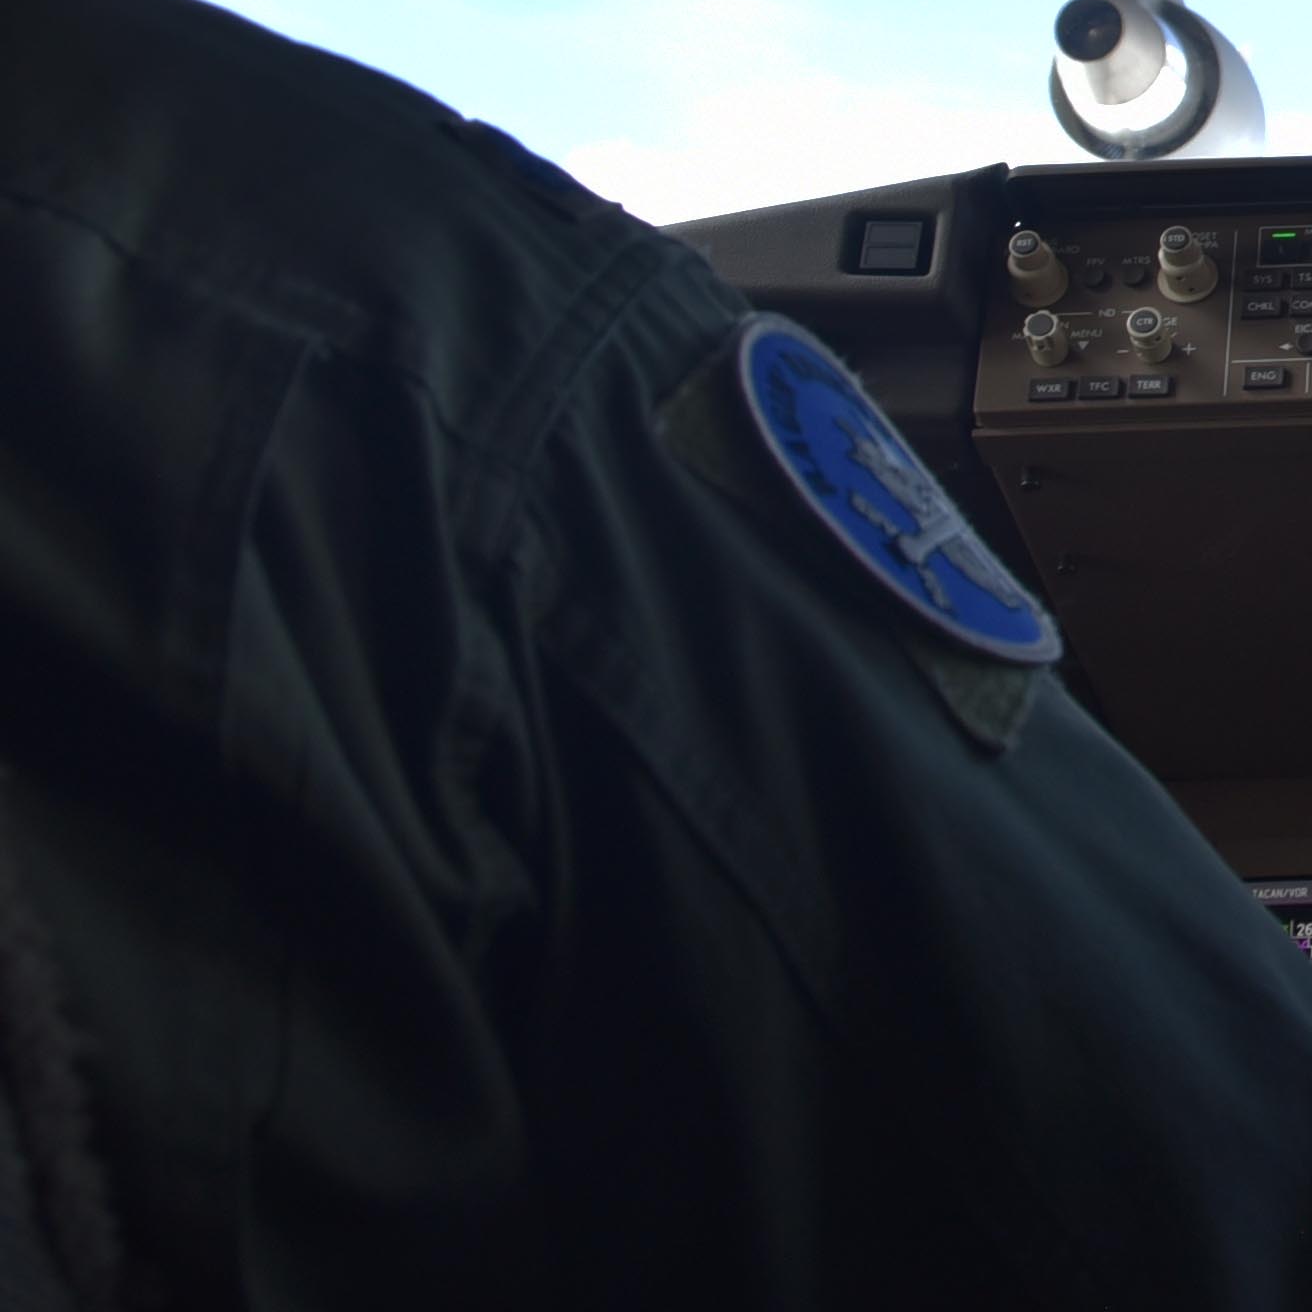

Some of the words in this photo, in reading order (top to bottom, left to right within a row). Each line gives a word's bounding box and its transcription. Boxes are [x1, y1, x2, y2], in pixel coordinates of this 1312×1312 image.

[1251, 372, 1276, 380] ENG
[1036, 384, 1062, 392] WXR
[1089, 382, 1109, 390] TFC
[1137, 380, 1161, 389] TERR
